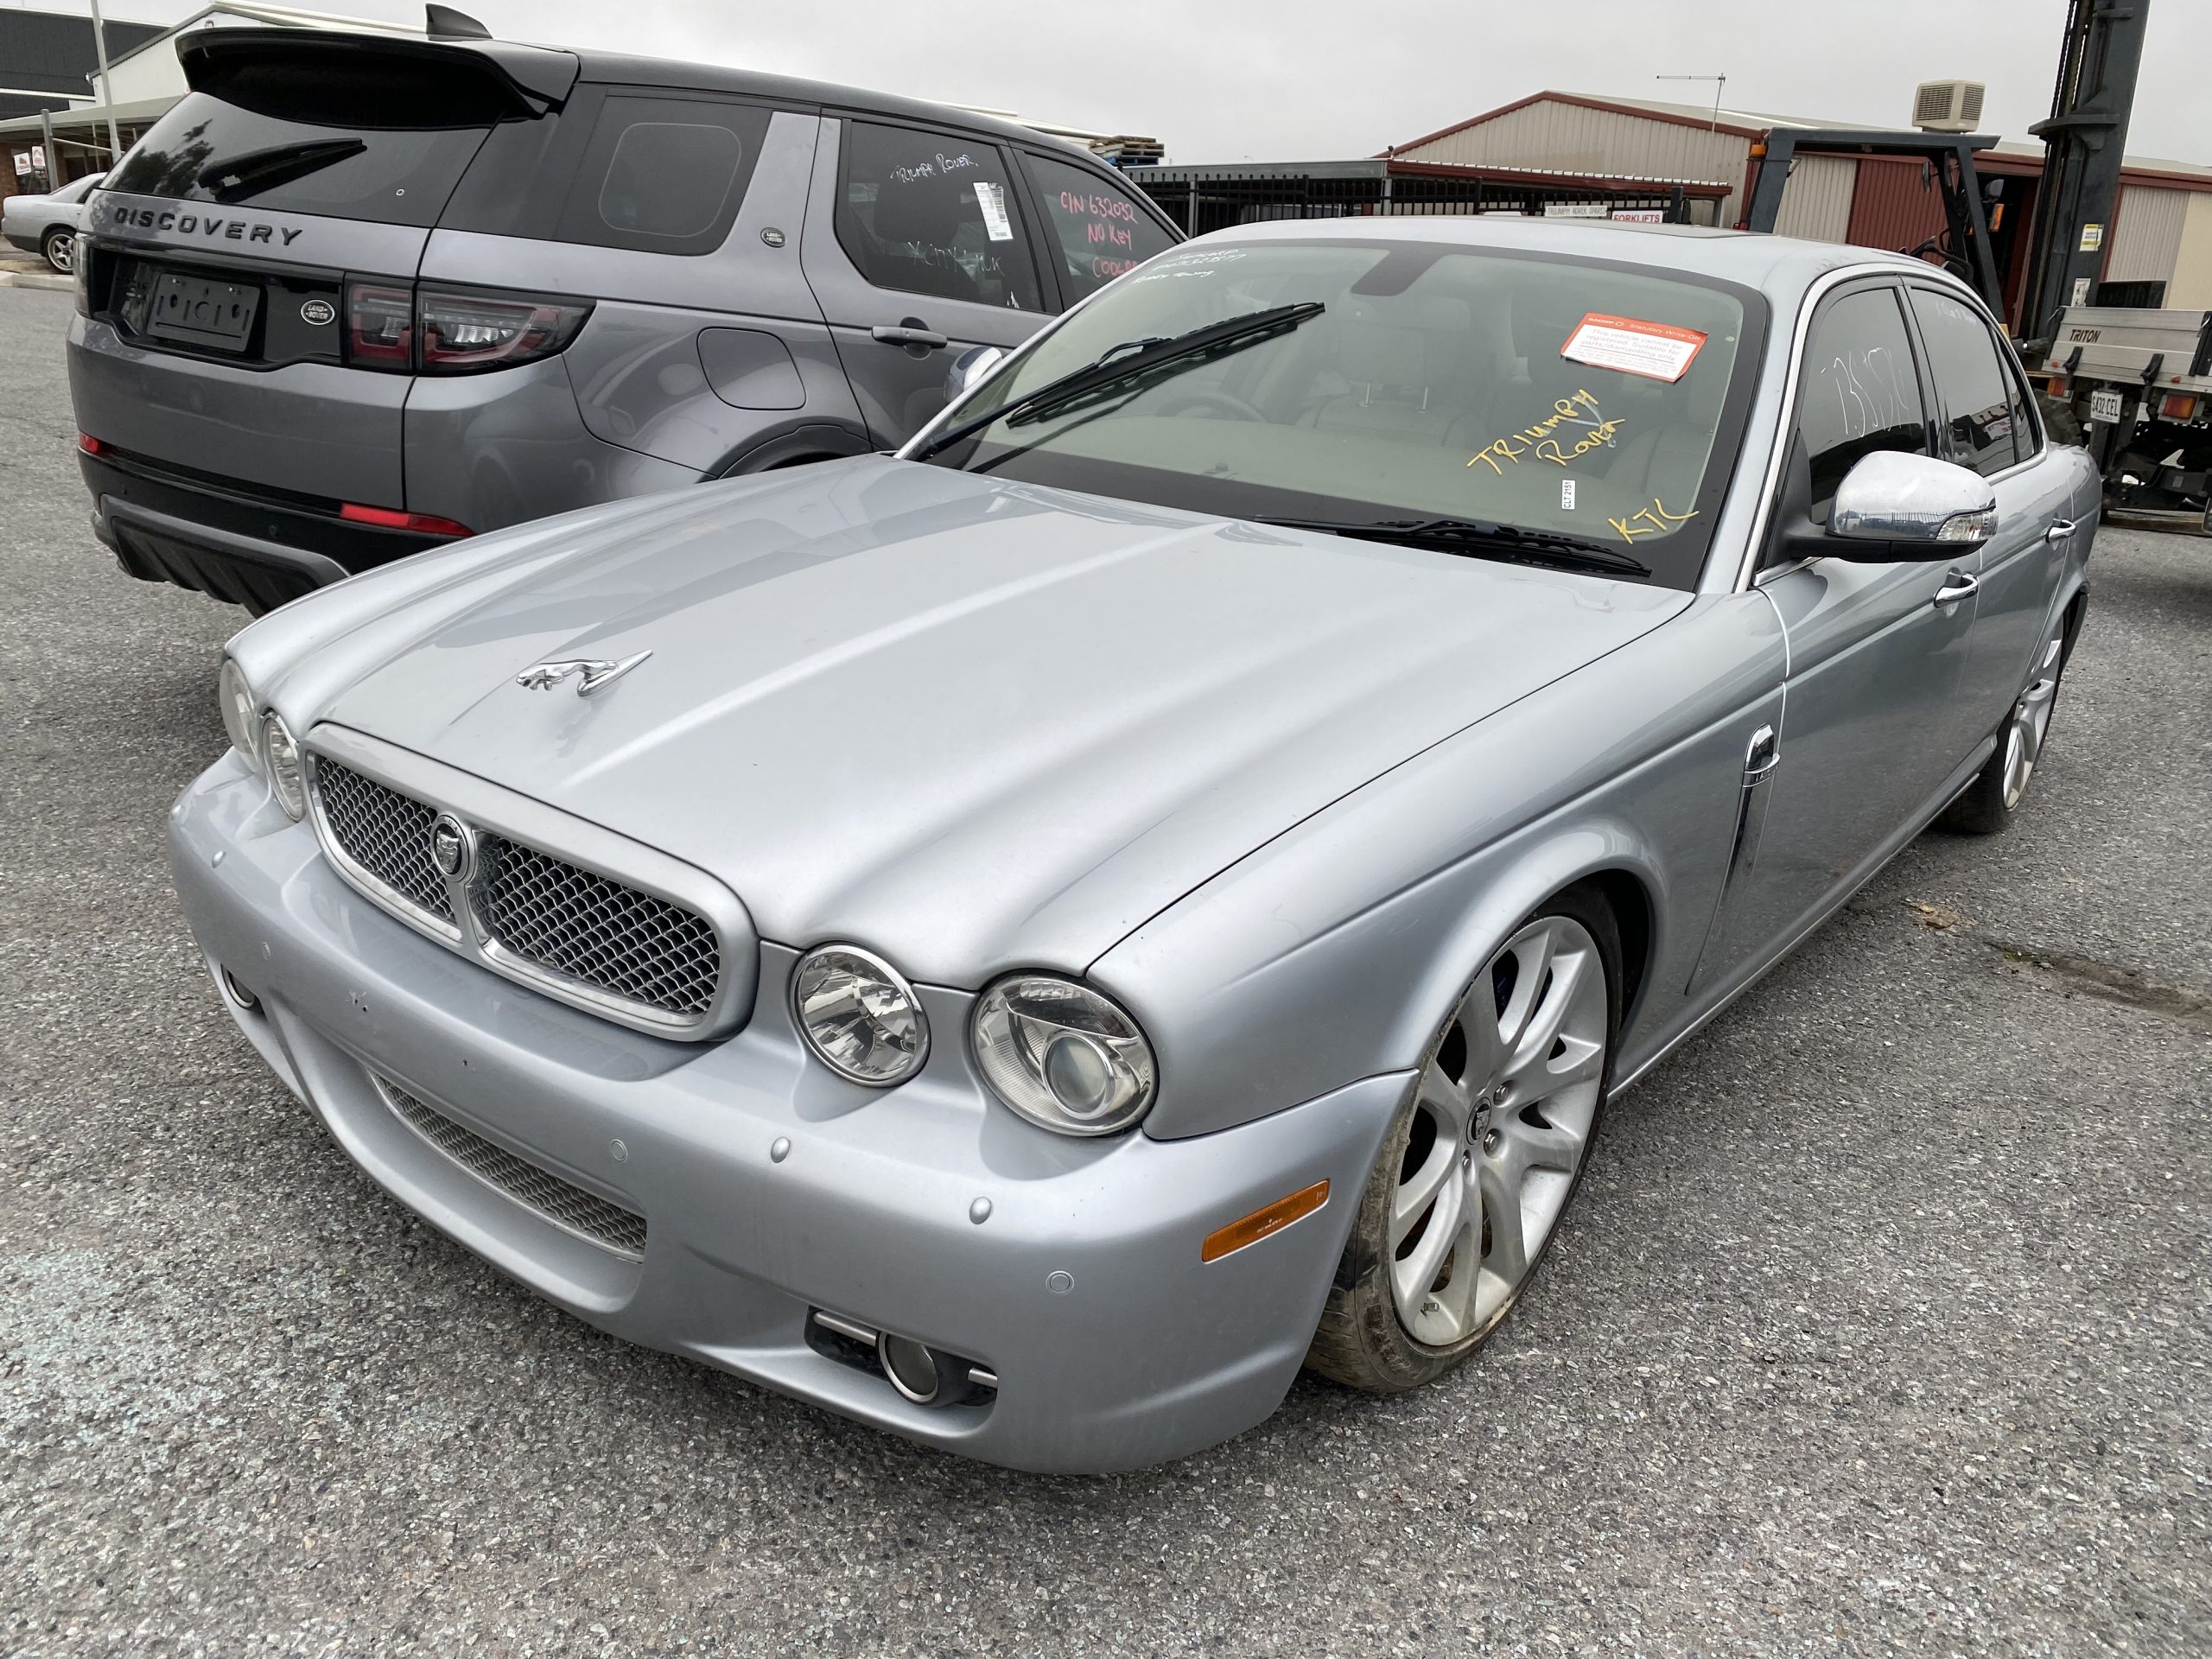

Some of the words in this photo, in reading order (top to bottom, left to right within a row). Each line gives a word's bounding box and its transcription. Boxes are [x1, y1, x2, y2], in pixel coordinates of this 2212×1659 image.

[1089, 194, 1139, 225] 632032
[1613, 213, 1660, 223] FORKLIFTS
[114, 207, 303, 246] DISCOVERY
[1087, 223, 1105, 244] NO
[1109, 224, 1132, 251] KEY
[1630, 323, 1664, 334] Statutory
[2069, 329, 2102, 343] TRITON
[1563, 481, 1572, 495] 2151
[1563, 496, 1572, 508] CLT
